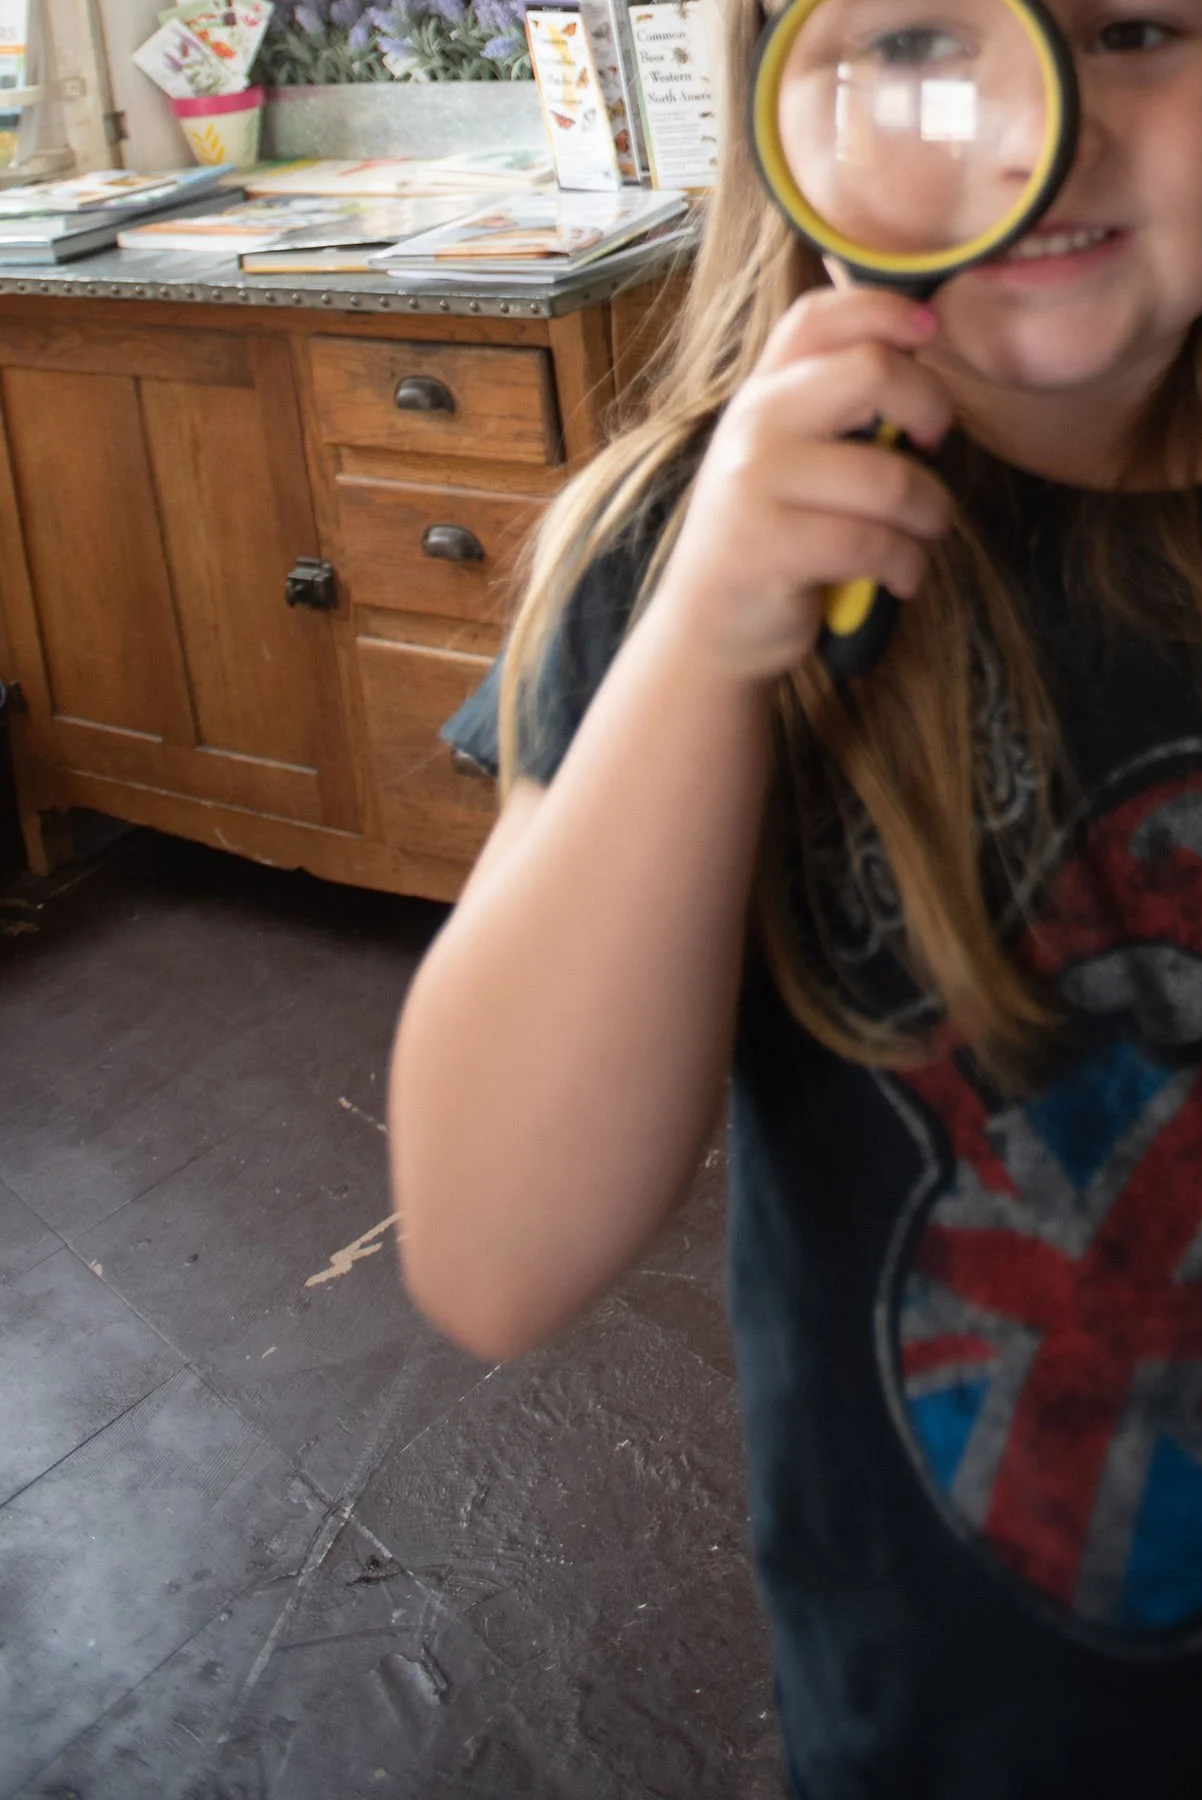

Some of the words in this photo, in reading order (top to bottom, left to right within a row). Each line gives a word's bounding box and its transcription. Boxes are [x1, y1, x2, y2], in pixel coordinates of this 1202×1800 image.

[637, 29, 686, 41] Common
[649, 70, 692, 82] Western
[648, 89, 677, 104] North
